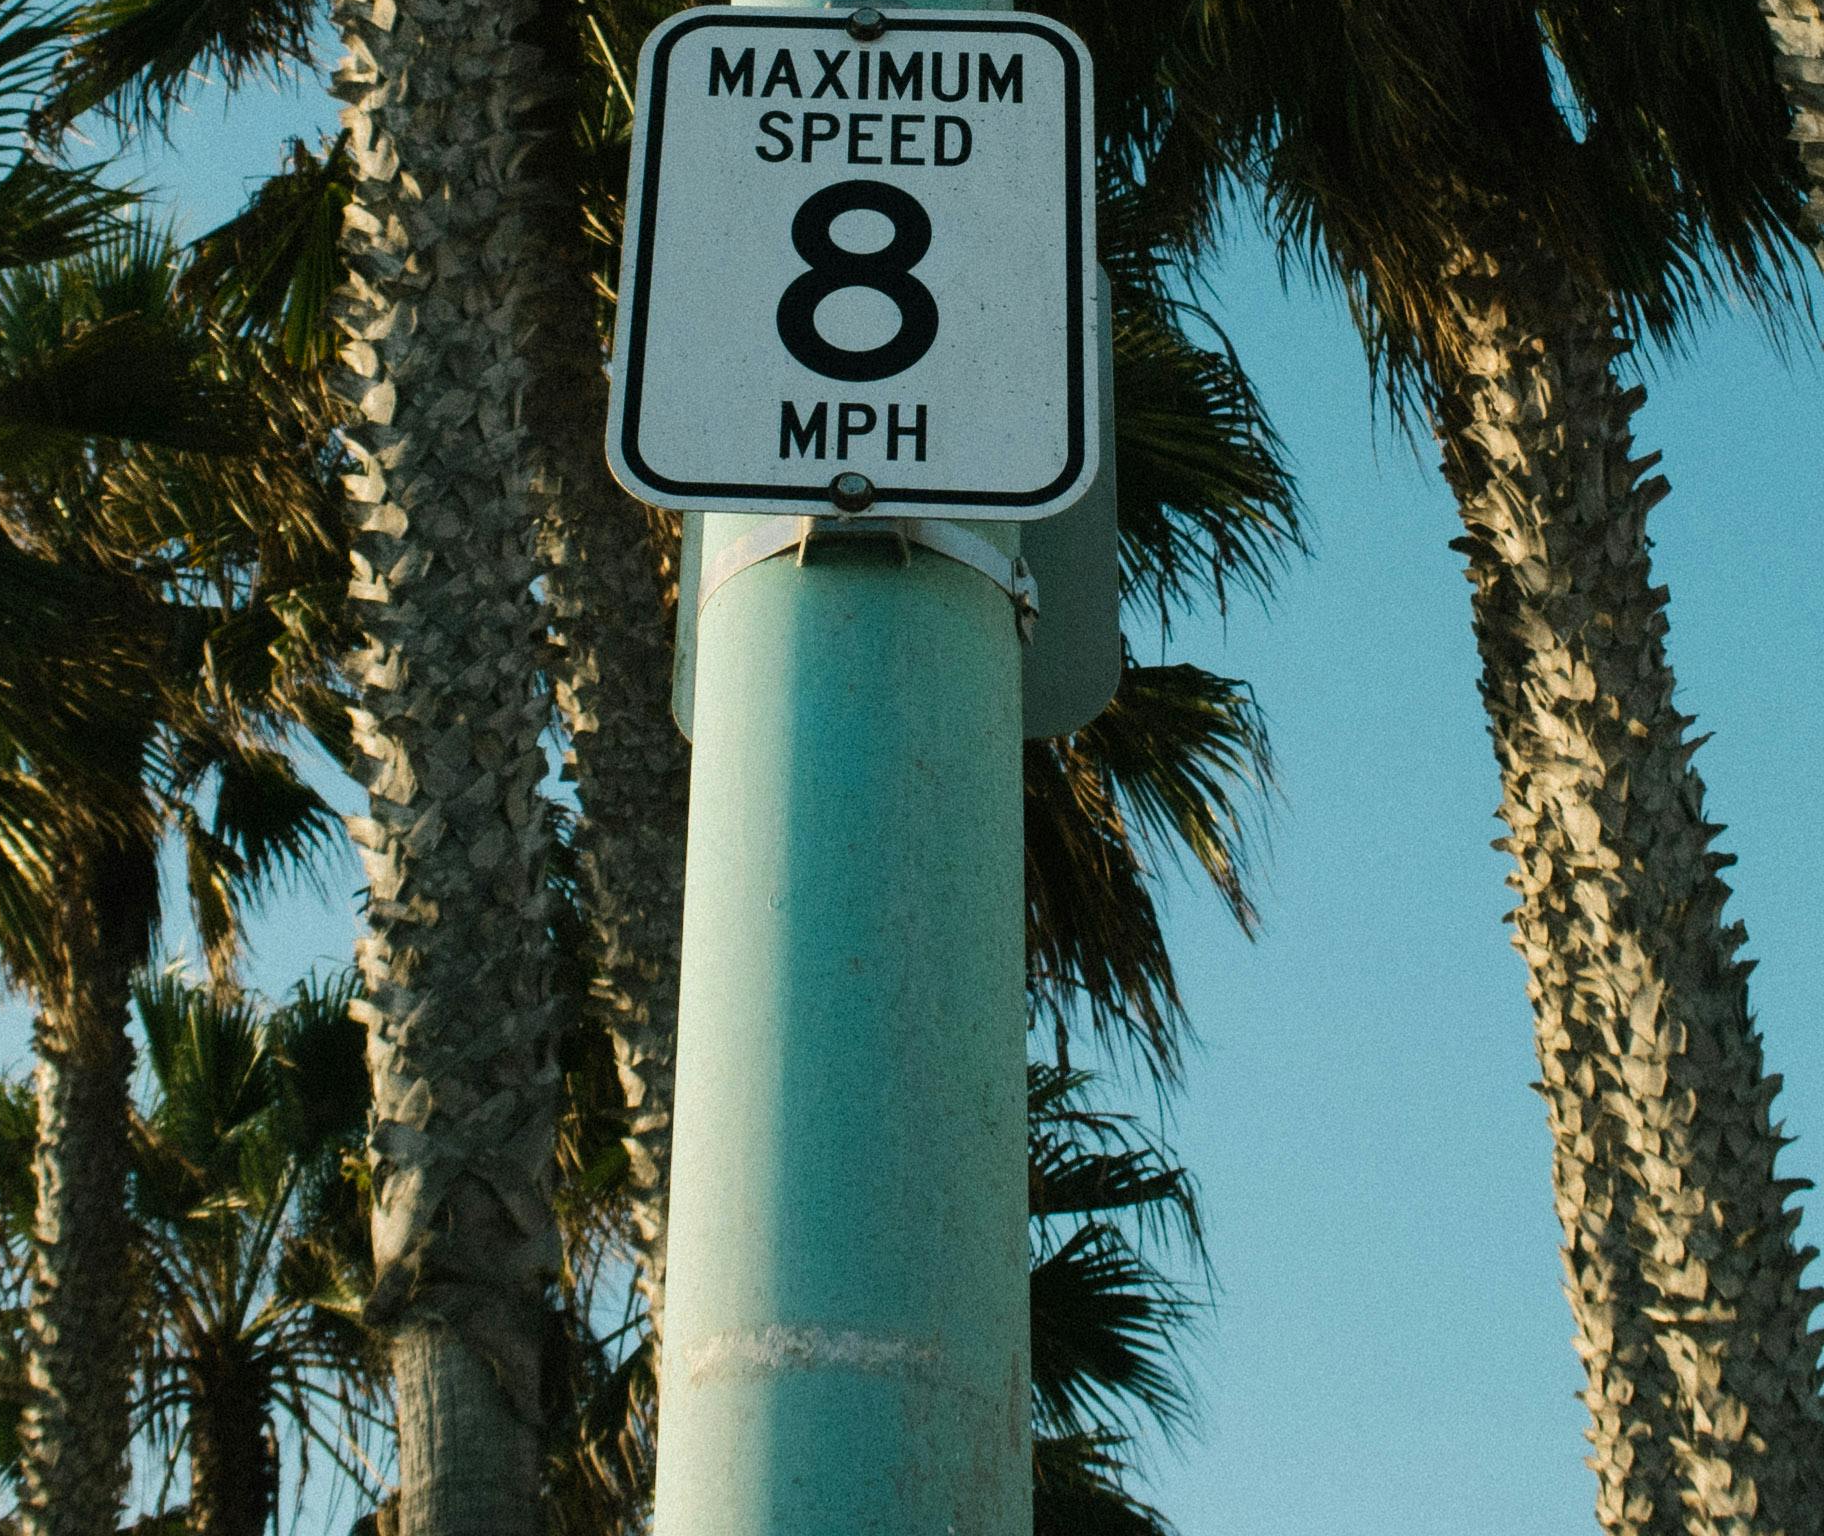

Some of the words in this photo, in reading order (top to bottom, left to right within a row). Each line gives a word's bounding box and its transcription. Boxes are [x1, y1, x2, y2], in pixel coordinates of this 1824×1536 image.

[708, 46, 1024, 104] MAXIMUM
[755, 110, 973, 167] SPEED
[776, 179, 940, 383] 8
[779, 400, 928, 462] MPH
